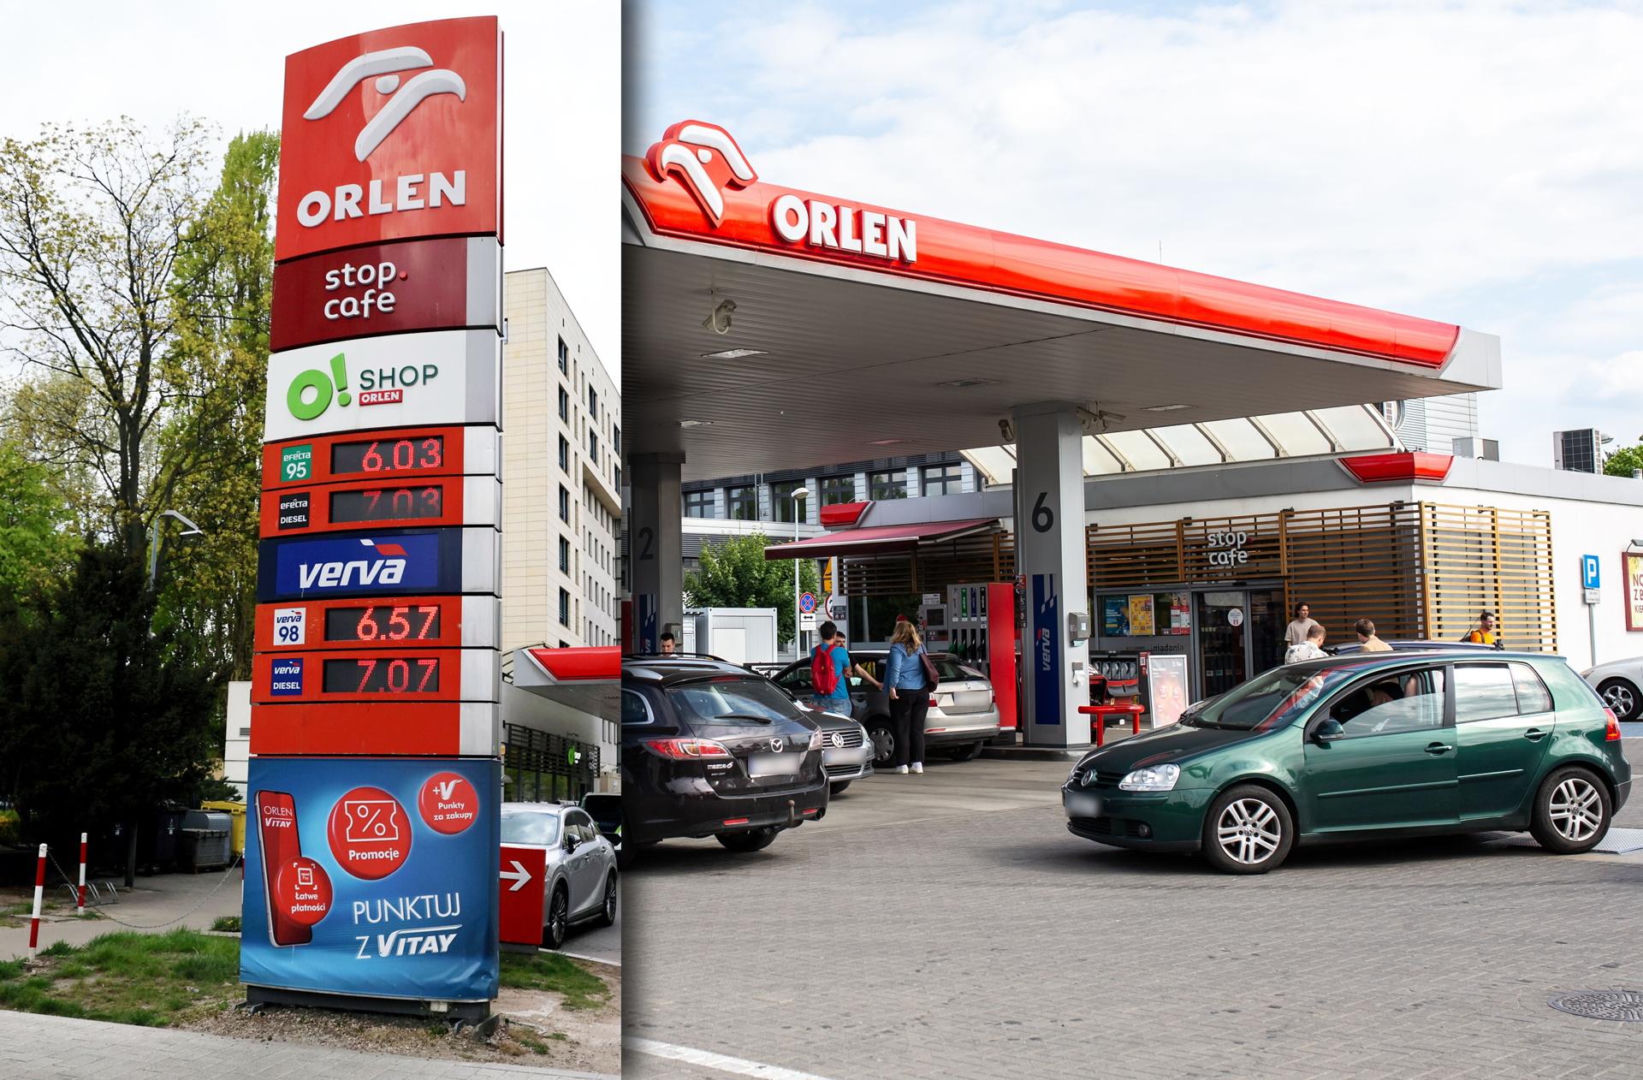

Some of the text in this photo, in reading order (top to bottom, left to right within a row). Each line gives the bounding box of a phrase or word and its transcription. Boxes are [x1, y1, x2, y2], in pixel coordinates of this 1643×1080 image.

[297, 170, 466, 228] ORLEN
[773, 194, 917, 263] ORLEN
[325, 261, 396, 290] stop
[323, 289, 396, 319] cafe
[286, 352, 439, 421] O! SHOP
[361, 391, 400, 404] ORLEN
[361, 438, 442, 472] 6.03
[286, 463, 307, 480] 95
[280, 514, 307, 524] DIESEL
[1031, 492, 1054, 533] 6
[638, 527, 654, 560] 2
[1207, 531, 1247, 549] stop
[1208, 548, 1248, 566] cafe
[299, 559, 407, 589] verva
[1587, 558, 1597, 584] P
[276, 614, 302, 624] verva
[357, 606, 439, 641] 6.57
[278, 626, 299, 642] 98
[1042, 627, 1051, 672] verva
[274, 665, 300, 675] verva
[357, 659, 438, 693] 7.07
[273, 681, 300, 691] DIESEL
[263, 805, 293, 817] ORLEN
[438, 802, 465, 812] Punkty
[265, 817, 292, 828] VITAY
[433, 811, 473, 822] za zakupy
[348, 849, 400, 862] Promocje
[295, 891, 318, 901] Łatwe
[291, 902, 326, 915] płatności
[353, 892, 462, 925] PUNKTUJ
[355, 924, 464, 960] Z VITAY
